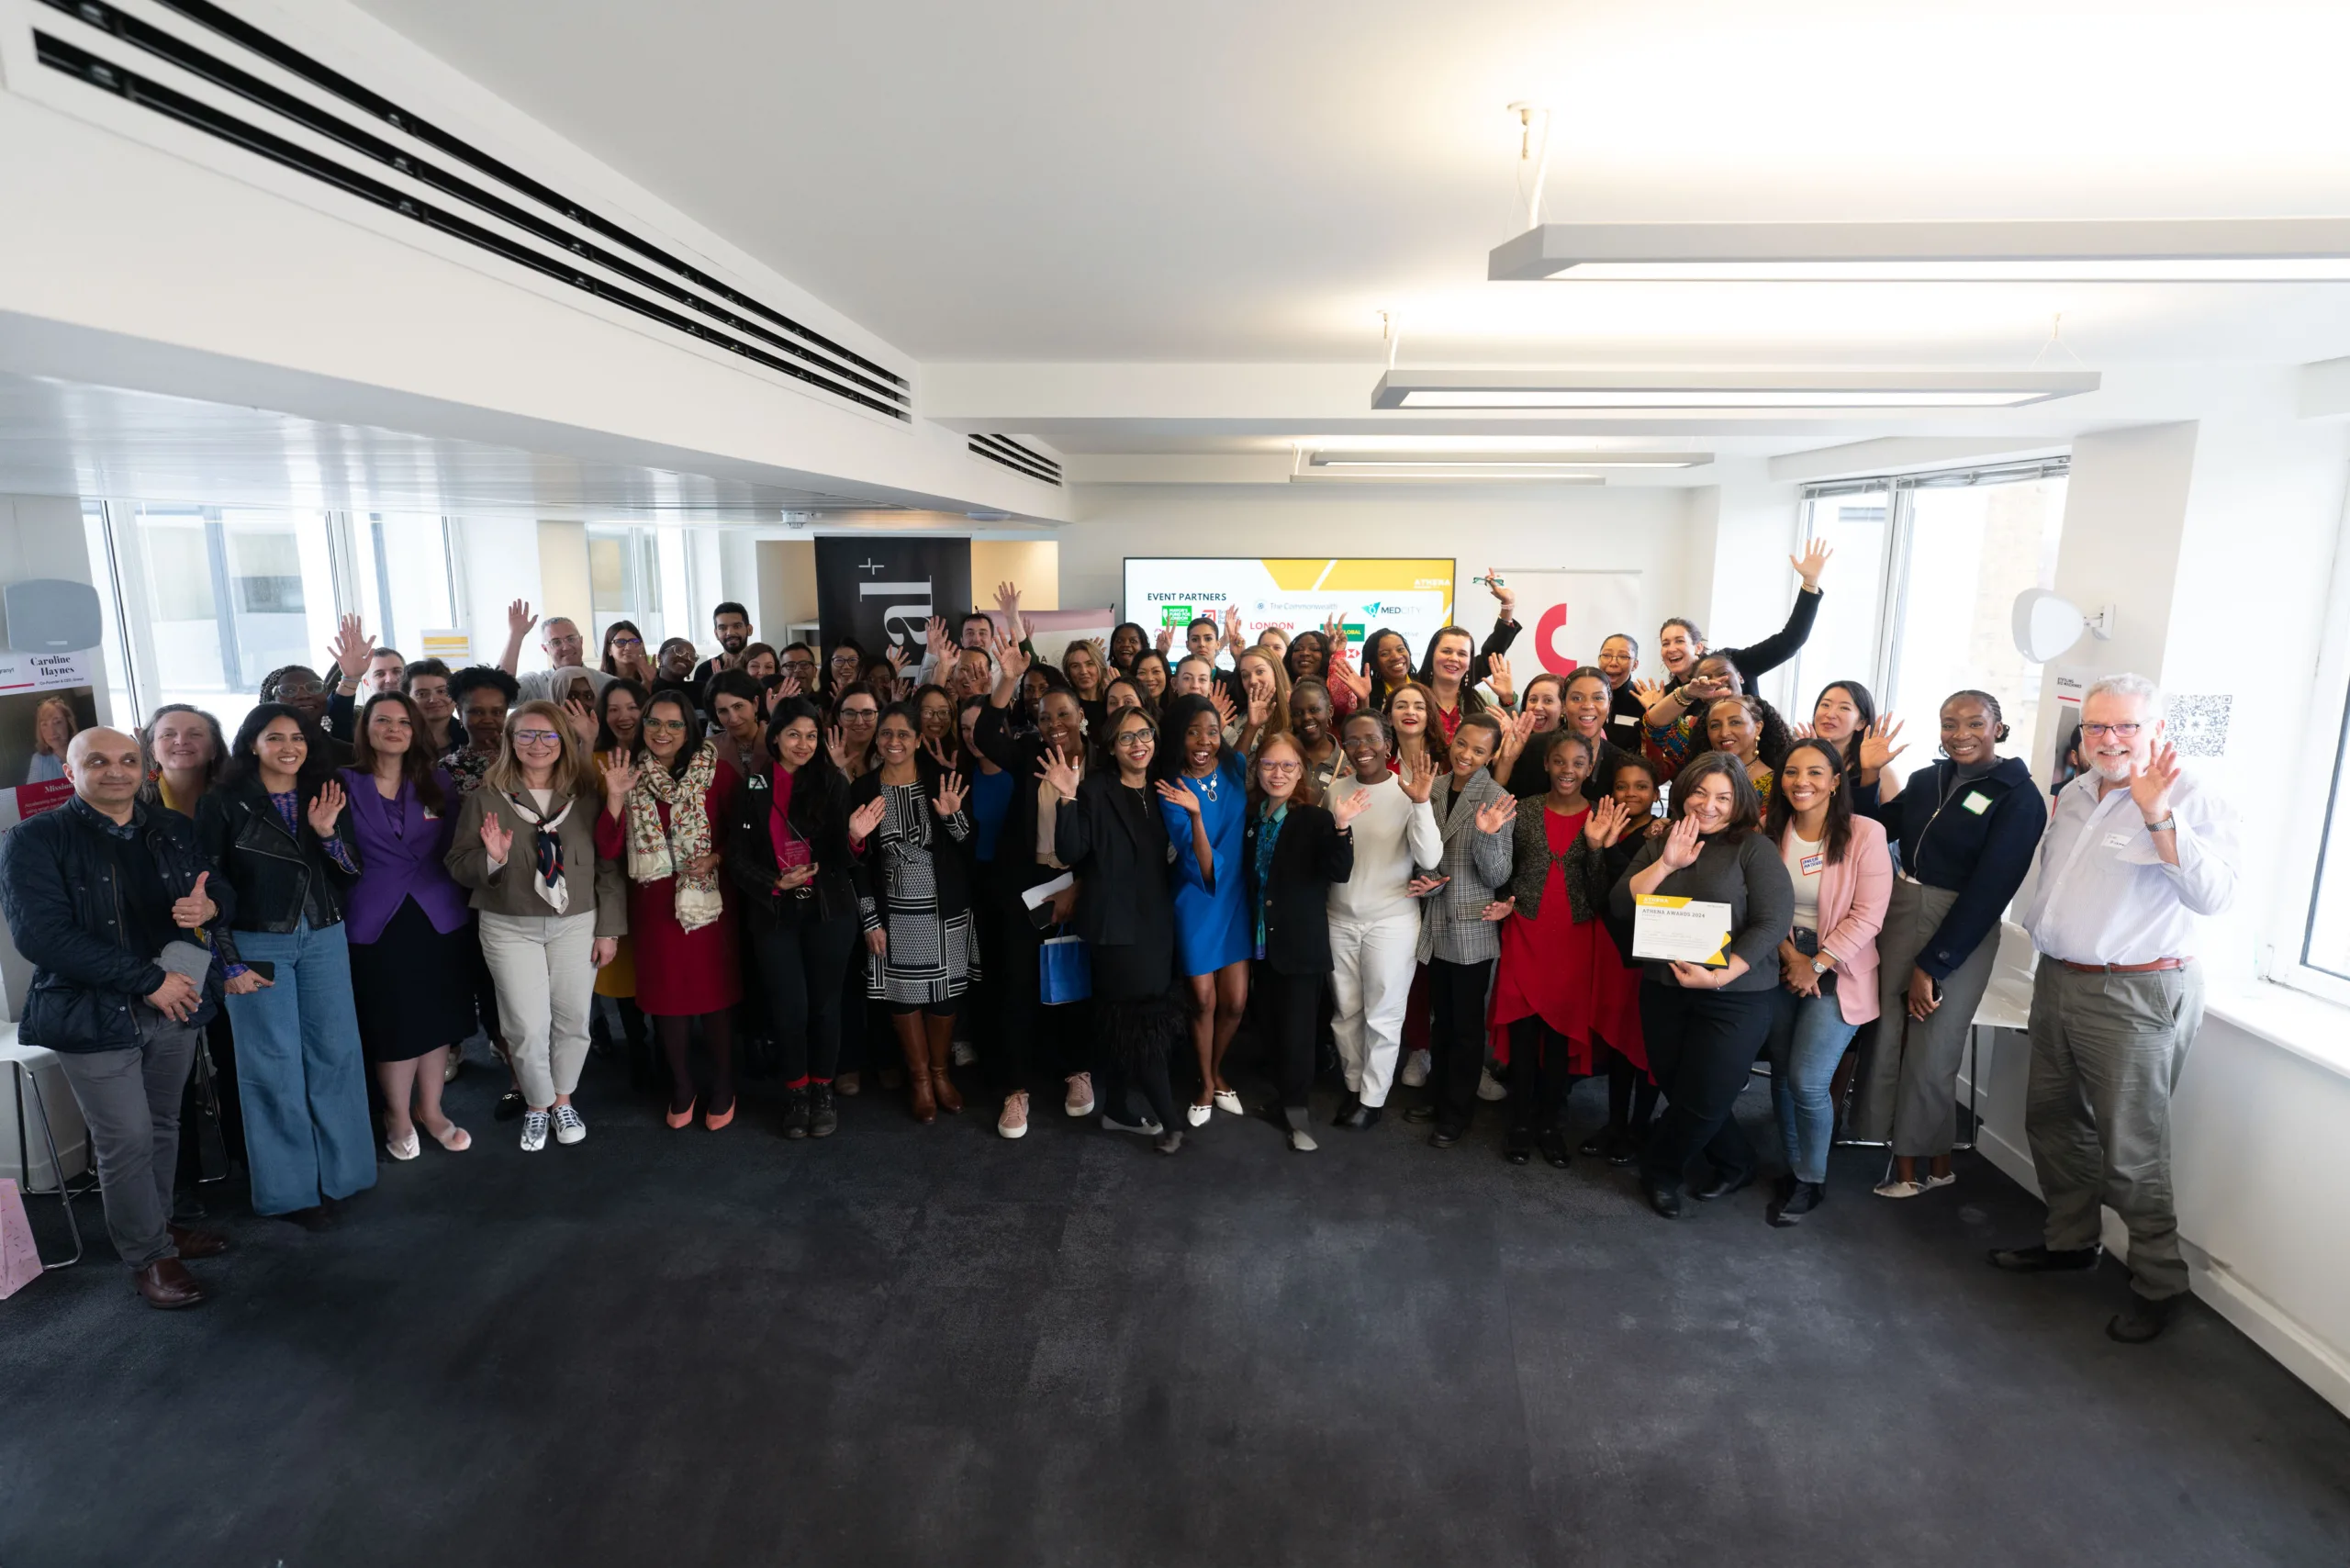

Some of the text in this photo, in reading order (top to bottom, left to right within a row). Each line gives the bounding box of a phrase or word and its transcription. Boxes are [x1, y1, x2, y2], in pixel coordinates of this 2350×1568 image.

[1414, 578, 1450, 587] ATHENA
[1147, 593, 1226, 601] EVENT PARTNERS
[1283, 602, 1338, 610] Commonwealth
[1249, 622, 1294, 630] LONDON
[30, 655, 71, 666] Caroline
[40, 666, 74, 677] Haynes
[44, 783, 73, 793] Mission
